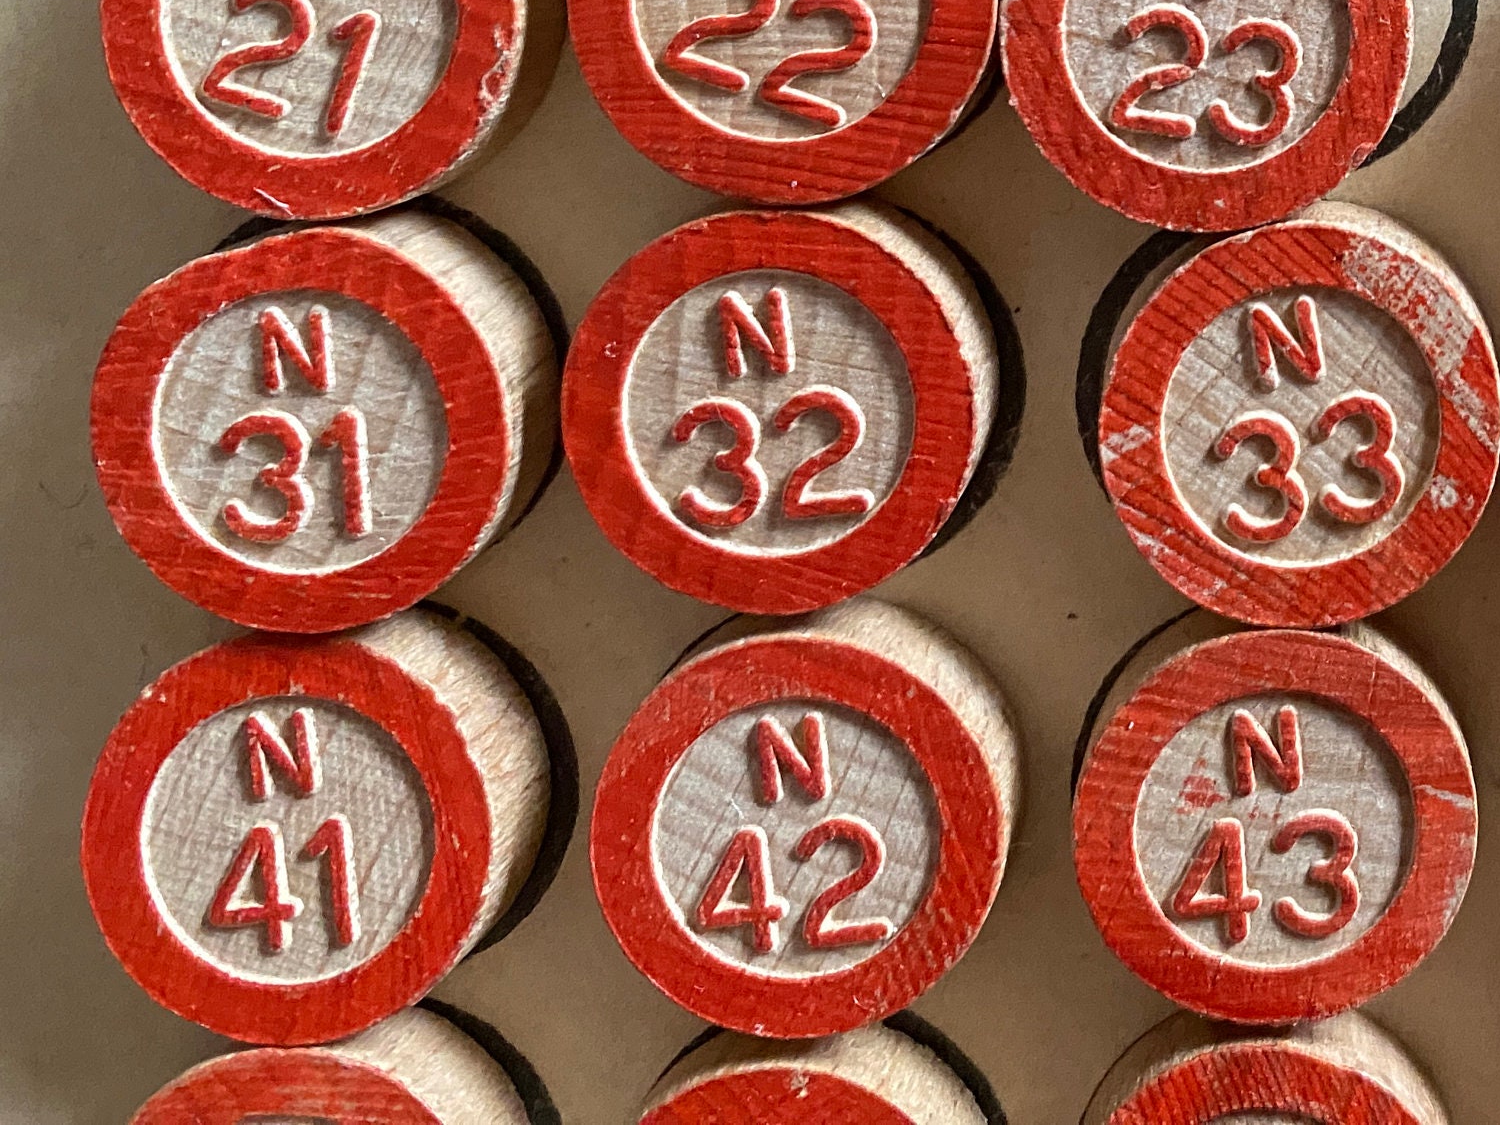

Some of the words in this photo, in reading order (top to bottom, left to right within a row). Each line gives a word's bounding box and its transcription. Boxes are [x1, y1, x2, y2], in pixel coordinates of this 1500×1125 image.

[1110, 2, 1303, 147] 23
[260, 305, 334, 394] N
[718, 286, 795, 378] N
[1249, 295, 1326, 391] N
[221, 405, 372, 543] 31
[673, 384, 875, 528] 32
[1215, 389, 1404, 543] 33
[245, 707, 319, 802] N
[755, 711, 833, 804] N
[1231, 704, 1303, 795] N
[208, 812, 362, 952] 41
[699, 814, 893, 953] 42
[1171, 808, 1360, 943] 43
